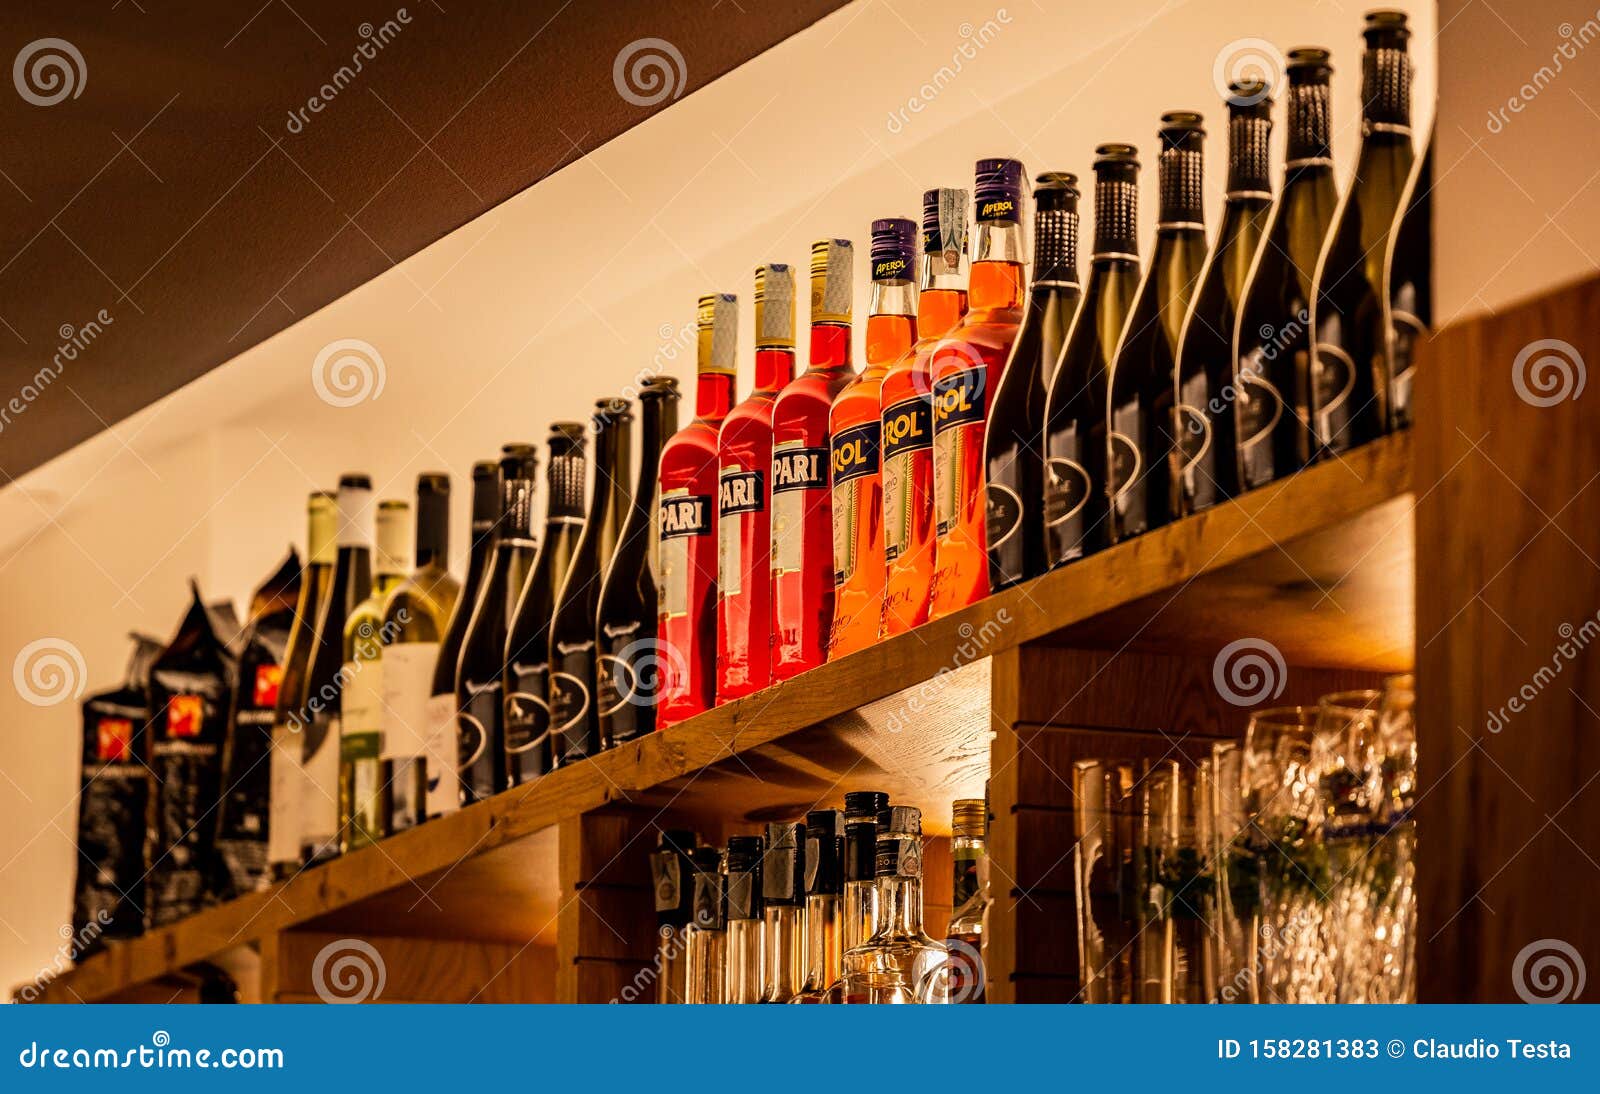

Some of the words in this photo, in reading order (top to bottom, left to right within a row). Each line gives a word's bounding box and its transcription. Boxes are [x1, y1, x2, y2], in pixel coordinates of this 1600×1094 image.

[982, 201, 1013, 216] APEROL
[876, 260, 906, 275] APEROL
[773, 454, 818, 485] PARI
